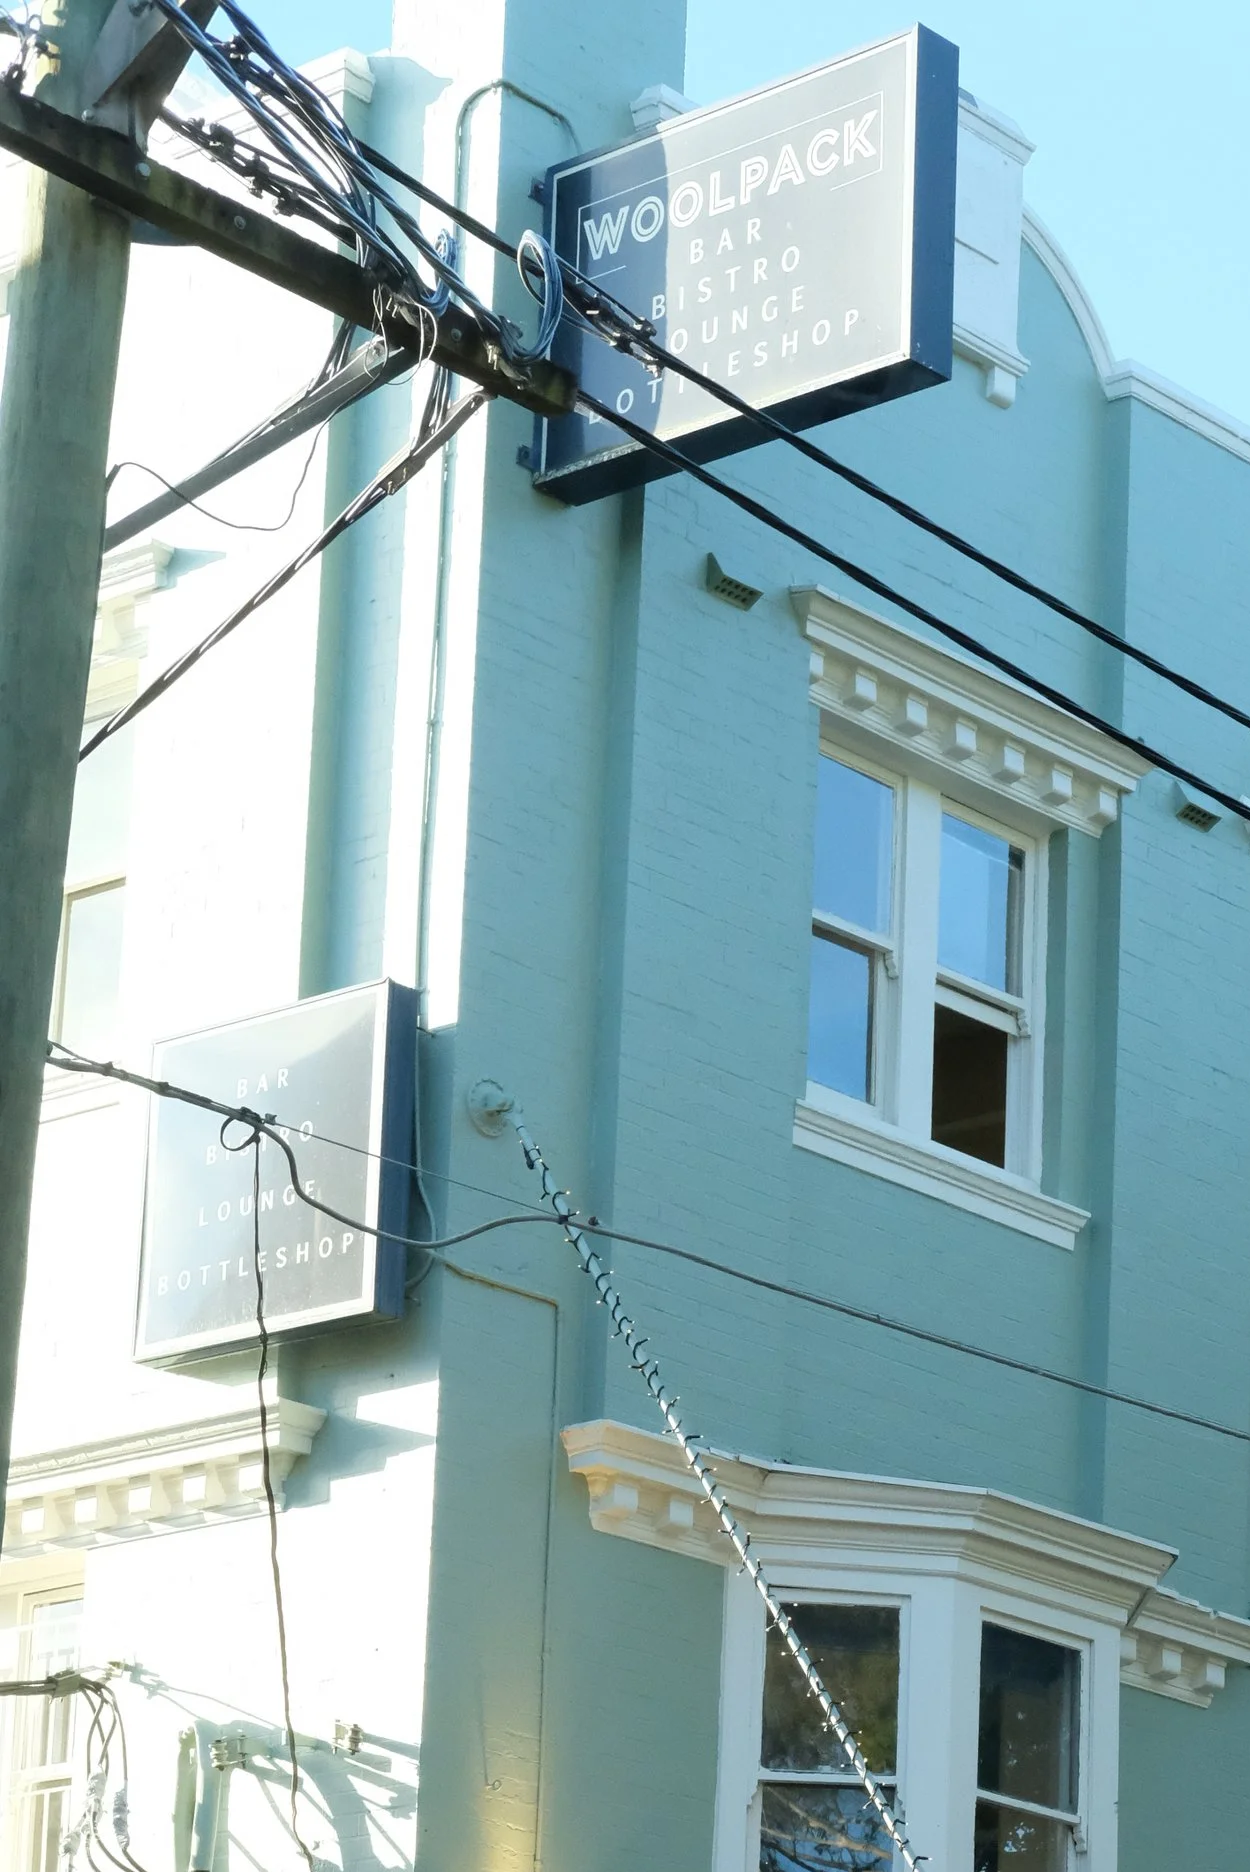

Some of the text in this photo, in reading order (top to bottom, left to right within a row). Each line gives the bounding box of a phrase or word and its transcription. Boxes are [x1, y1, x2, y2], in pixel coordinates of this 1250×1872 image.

[583, 110, 879, 259] WOOLPACK
[689, 216, 762, 265] BAR
[651, 245, 801, 322] BISTRO
[650, 286, 806, 357] OUNGE
[236, 1068, 290, 1098] BAR
[157, 1233, 355, 1297] BOTTLESHOP
